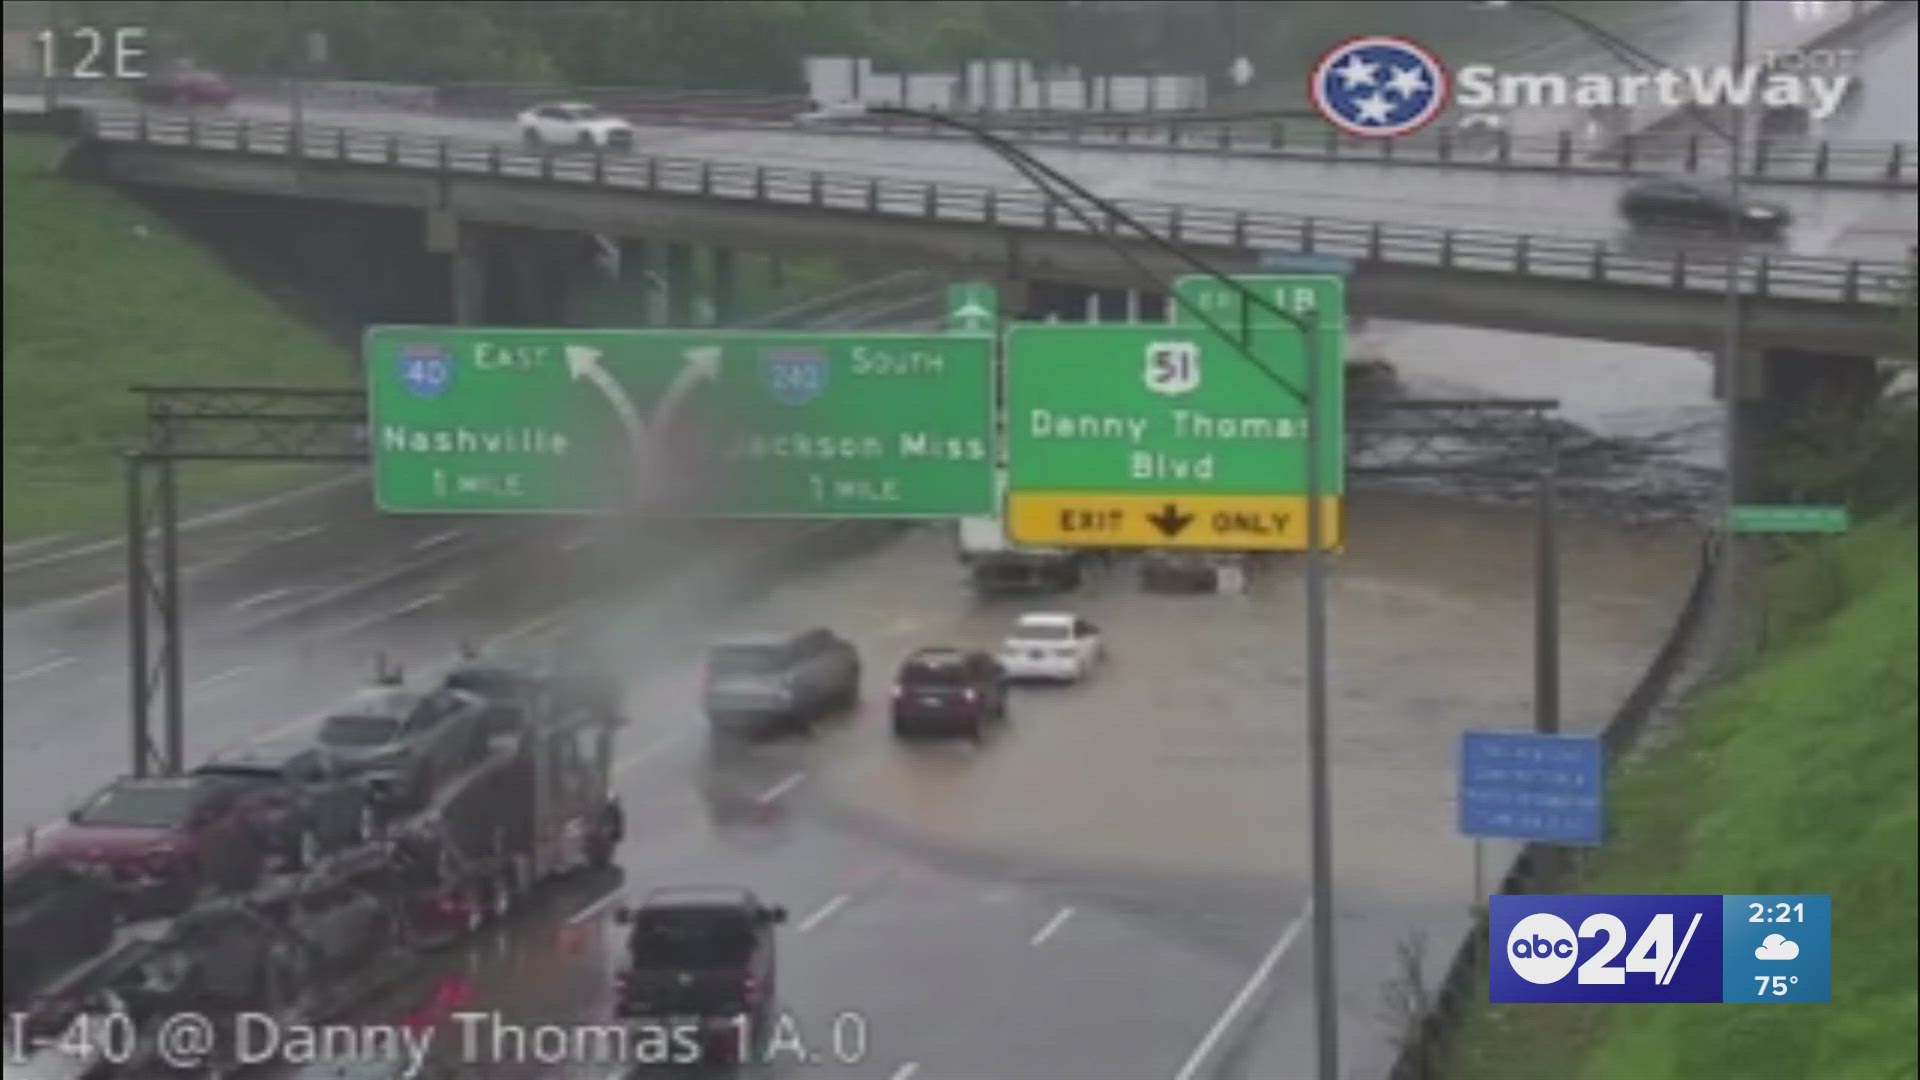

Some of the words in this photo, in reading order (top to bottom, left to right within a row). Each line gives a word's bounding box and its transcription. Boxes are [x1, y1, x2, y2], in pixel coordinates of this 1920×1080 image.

[406, 359, 447, 385] 40
[1156, 351, 1189, 383] 51
[383, 424, 569, 455] Nashville
[1031, 409, 1147, 444] Danny
[727, 433, 883, 460] ackson
[901, 432, 985, 461] Miss
[1131, 450, 1214, 479] Blvd
[1060, 509, 1124, 533] EXIT
[1212, 510, 1291, 535] ONLY
